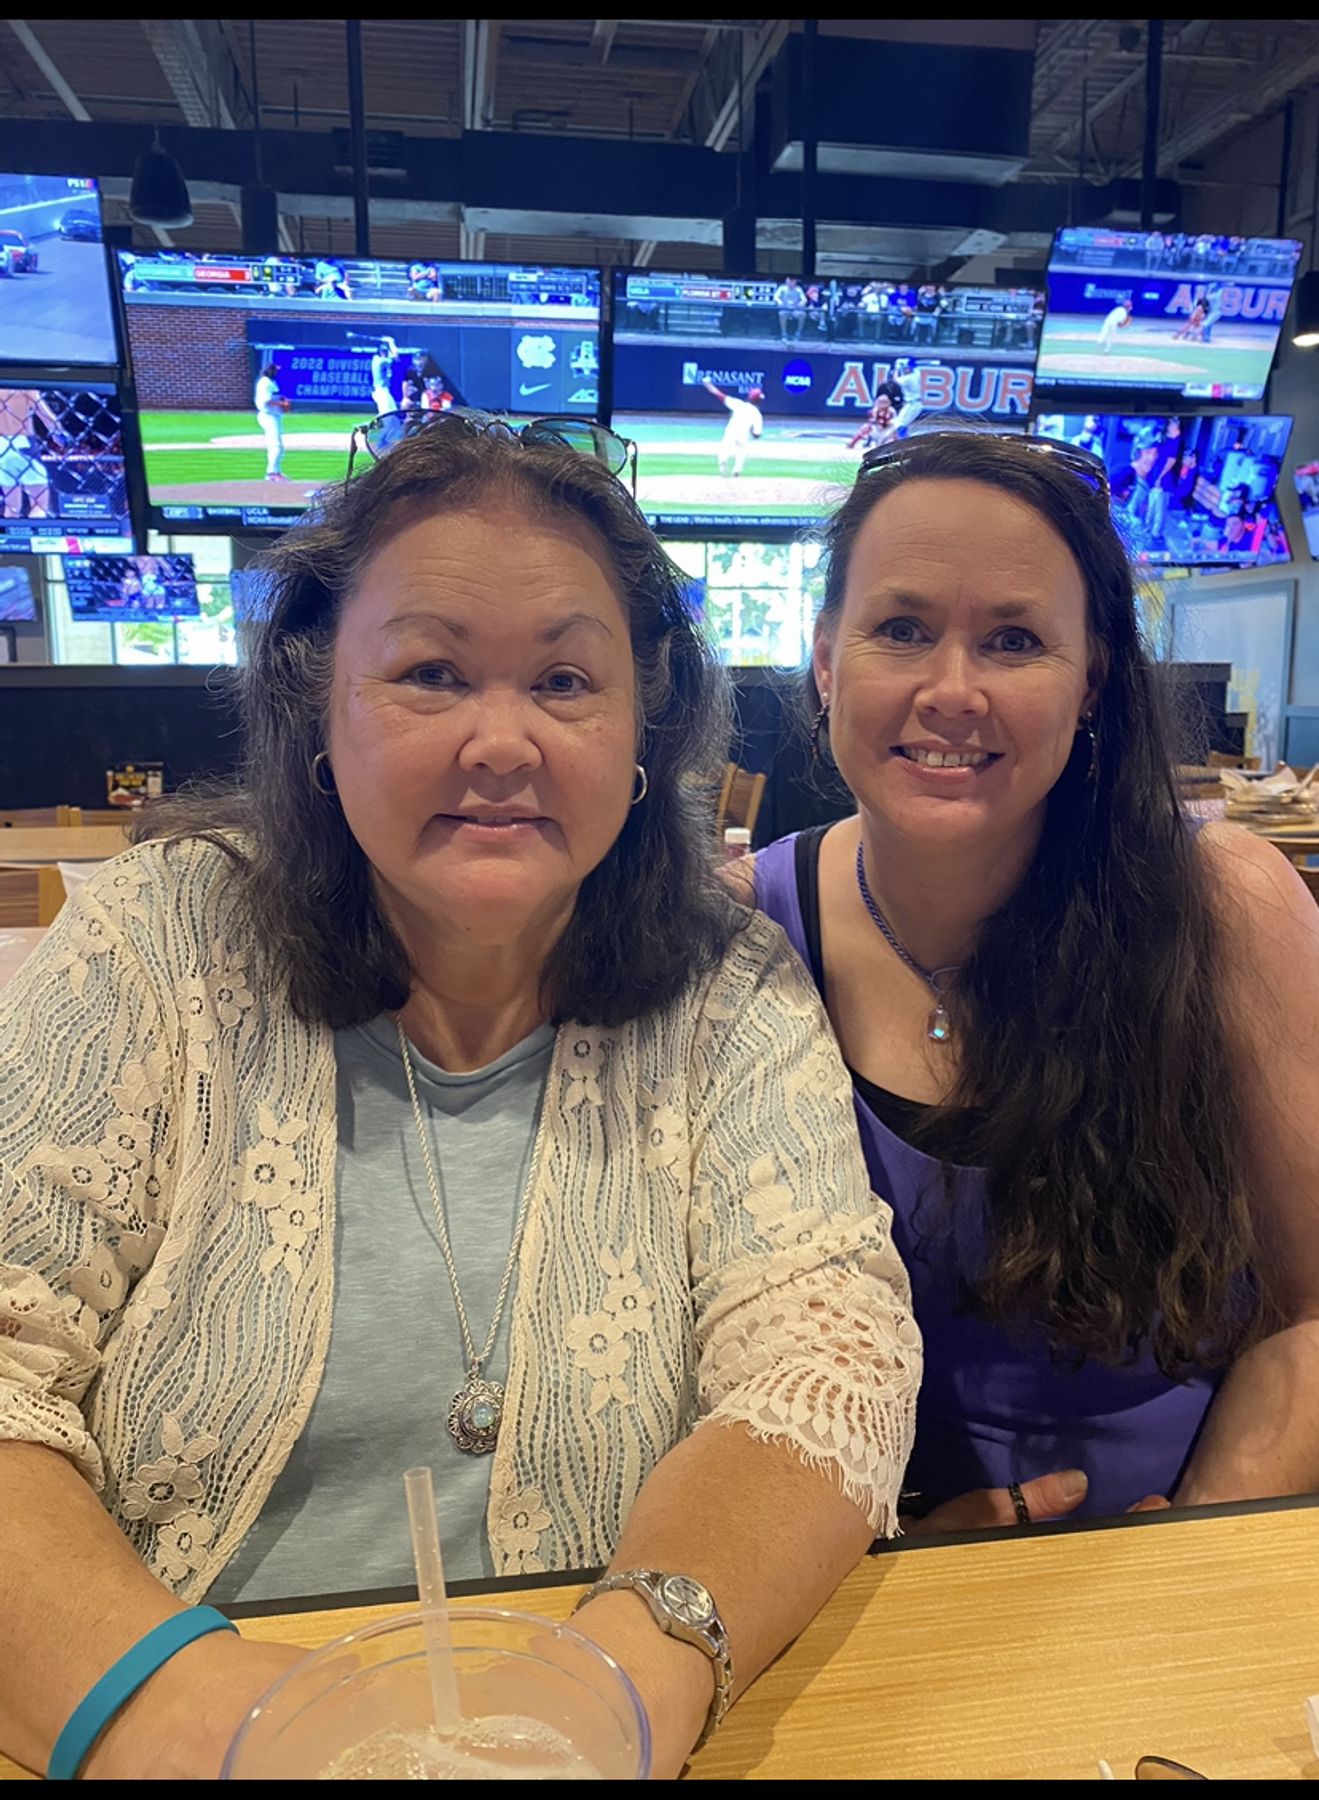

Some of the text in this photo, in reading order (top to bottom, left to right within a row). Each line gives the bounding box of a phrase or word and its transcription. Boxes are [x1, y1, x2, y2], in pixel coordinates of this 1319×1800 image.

[1164, 283, 1291, 320] ABUR
[291, 357, 372, 371] 2022 DIVISIO
[312, 370, 370, 384] BASEBALL
[826, 361, 1034, 413] ABUR
